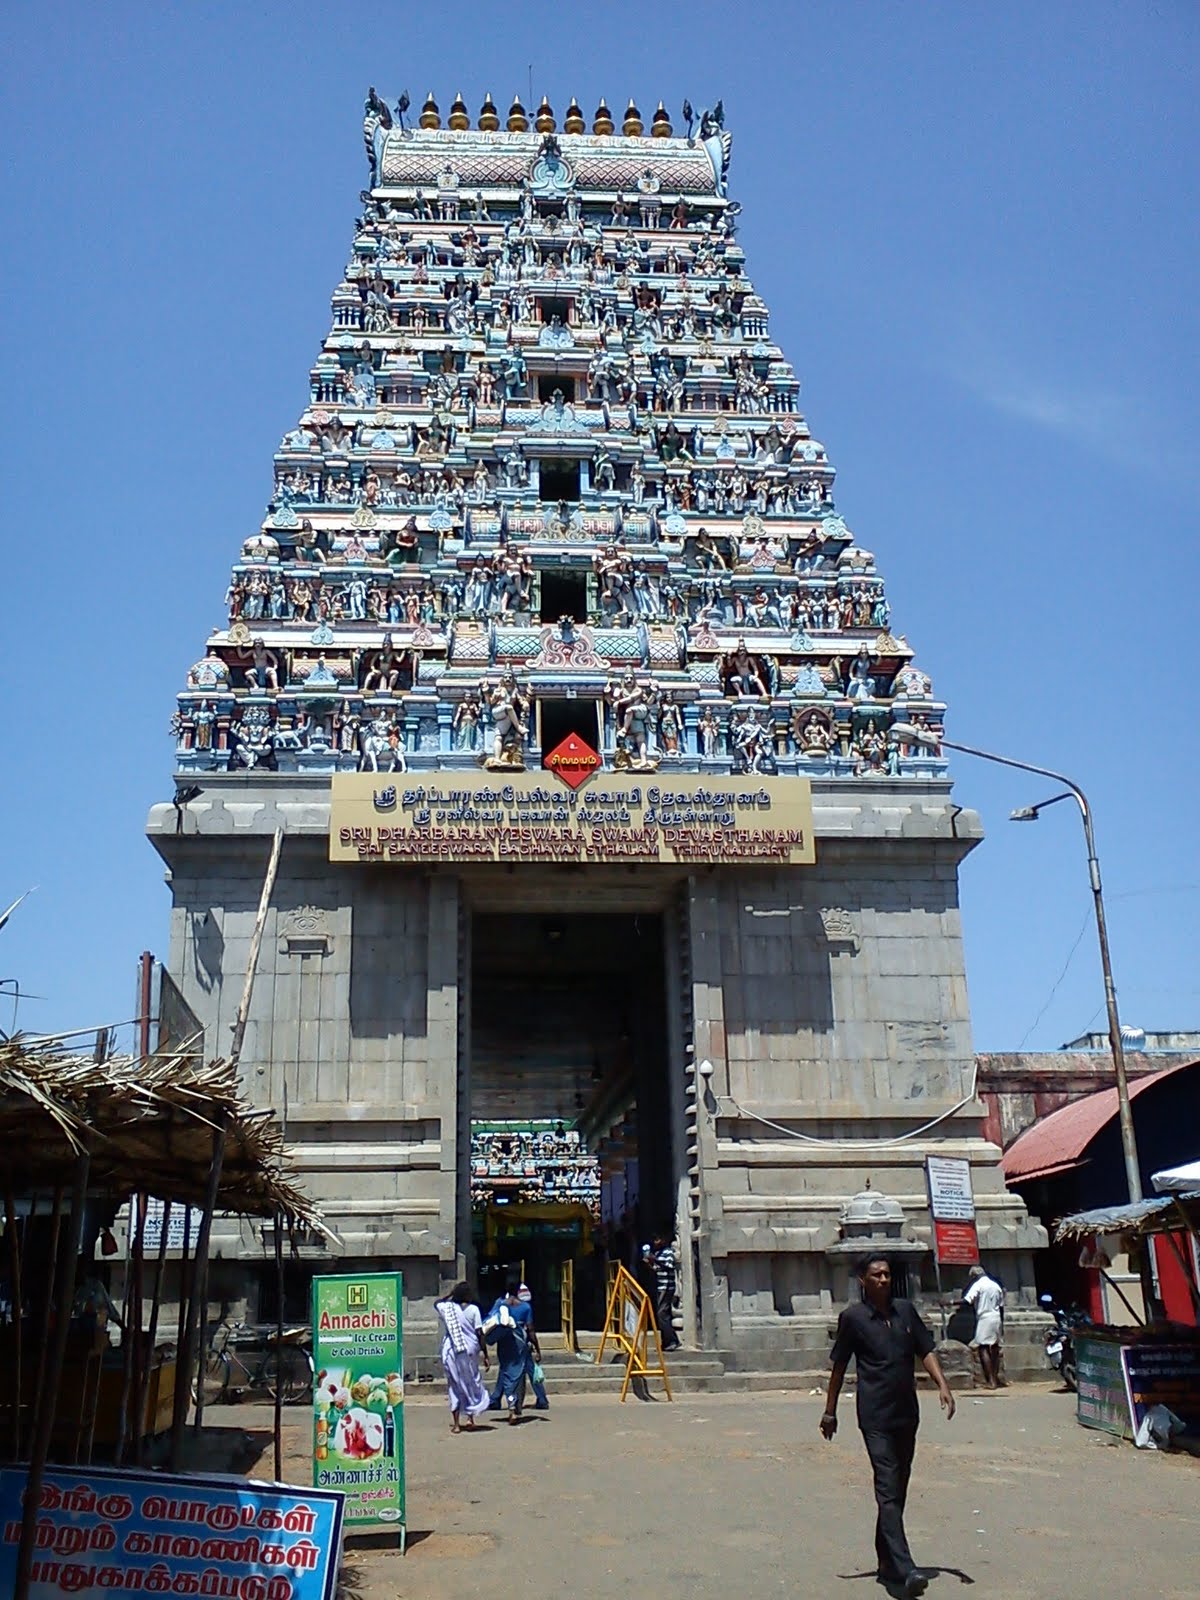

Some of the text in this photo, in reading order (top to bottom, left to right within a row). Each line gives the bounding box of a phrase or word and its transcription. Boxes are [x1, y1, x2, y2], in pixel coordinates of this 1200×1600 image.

[551, 754, 597, 765] சிவமயம்
[647, 786, 770, 806] தேவஸ்தானம்
[508, 807, 569, 821] பகவான்
[577, 807, 631, 823] ஸ்தலம்
[643, 808, 735, 826] திருநள்ளாறு
[340, 826, 802, 844] SRI DHARBARANYESWARA SWAMY DEVASTHANAM
[358, 842, 791, 857] SRI SANEESWARA BAGHAVAN STHALAM THIRUNALLARU
[354, 1334, 366, 1343] Ice
[368, 1332, 396, 1342] Cream
[331, 1346, 384, 1357] & Cool Drinks
[141, 1496, 318, 1533] பொருட்கள்
[123, 1530, 320, 1570] காலணிகள்
